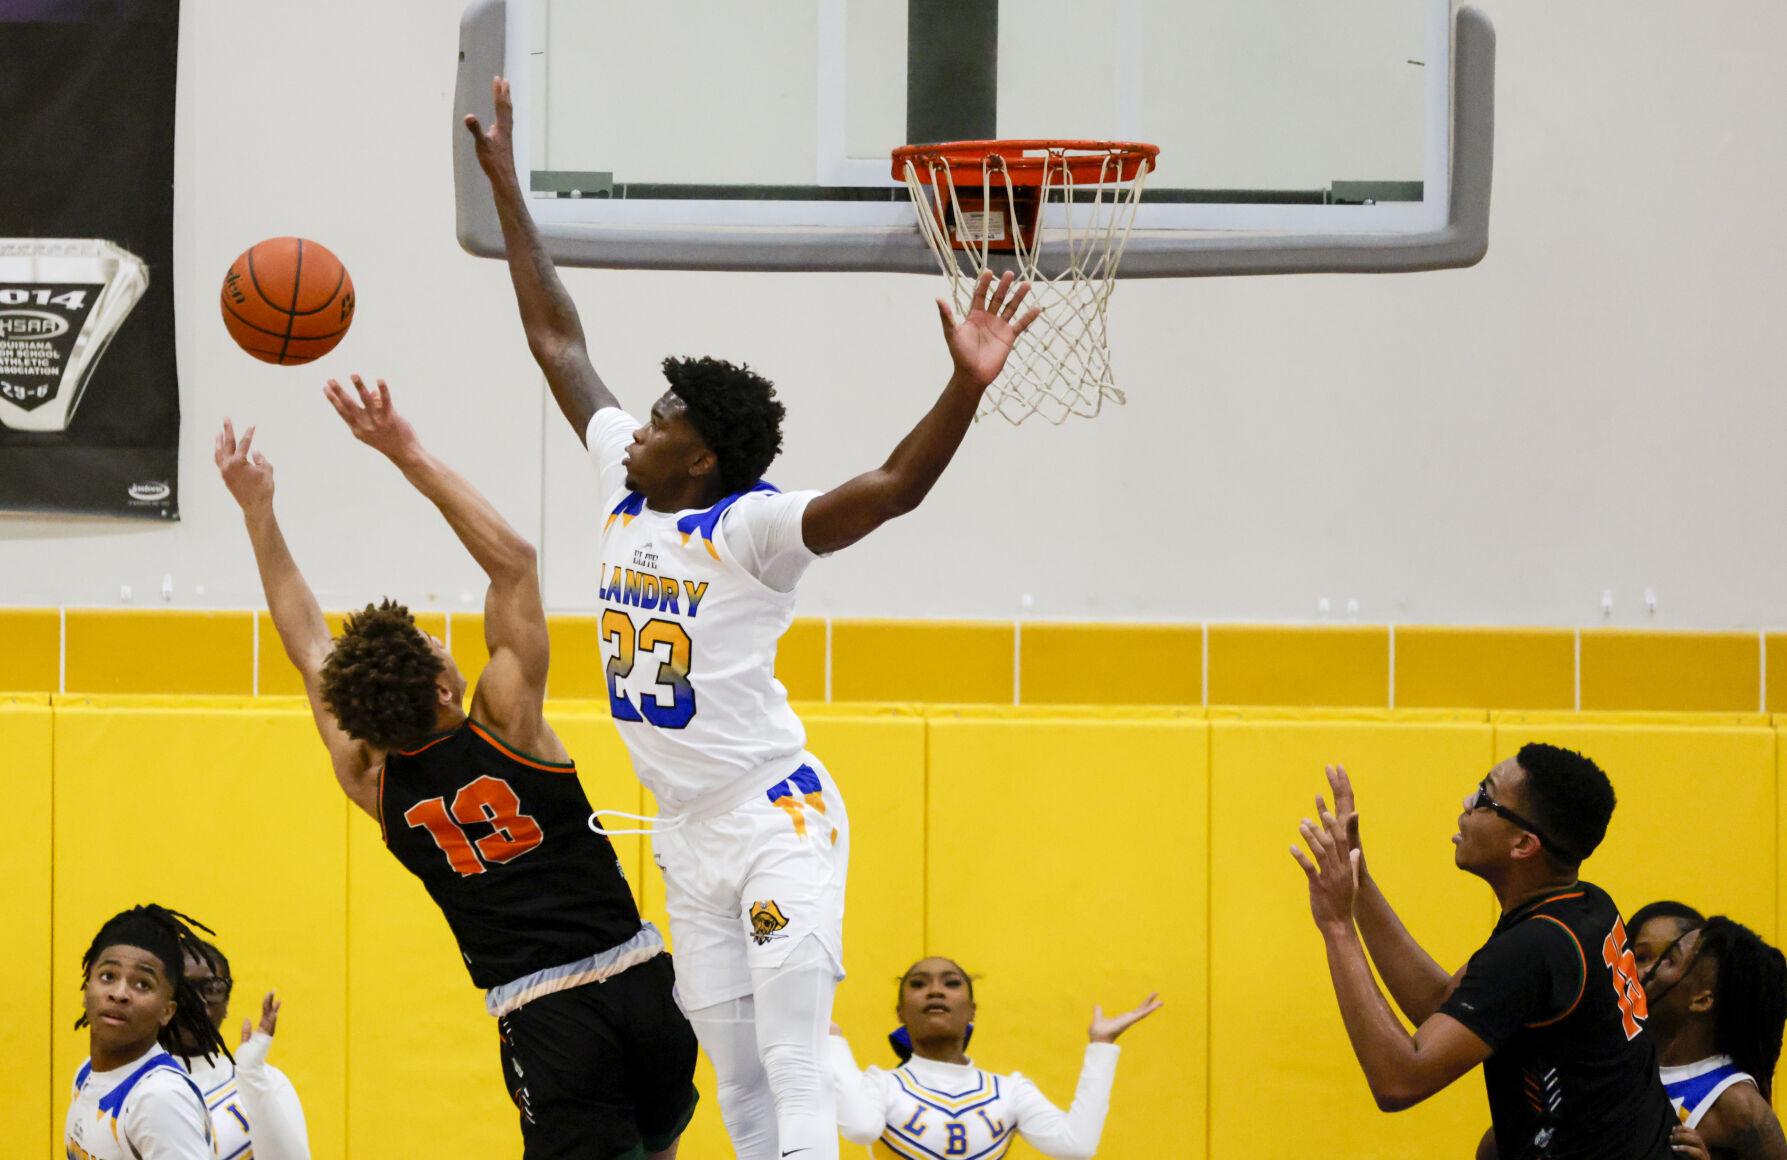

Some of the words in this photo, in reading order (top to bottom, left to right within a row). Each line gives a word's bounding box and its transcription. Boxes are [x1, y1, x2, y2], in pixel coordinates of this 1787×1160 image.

[599, 563, 709, 618] LANDRY
[602, 608, 697, 730] 23
[404, 774, 544, 878] 13
